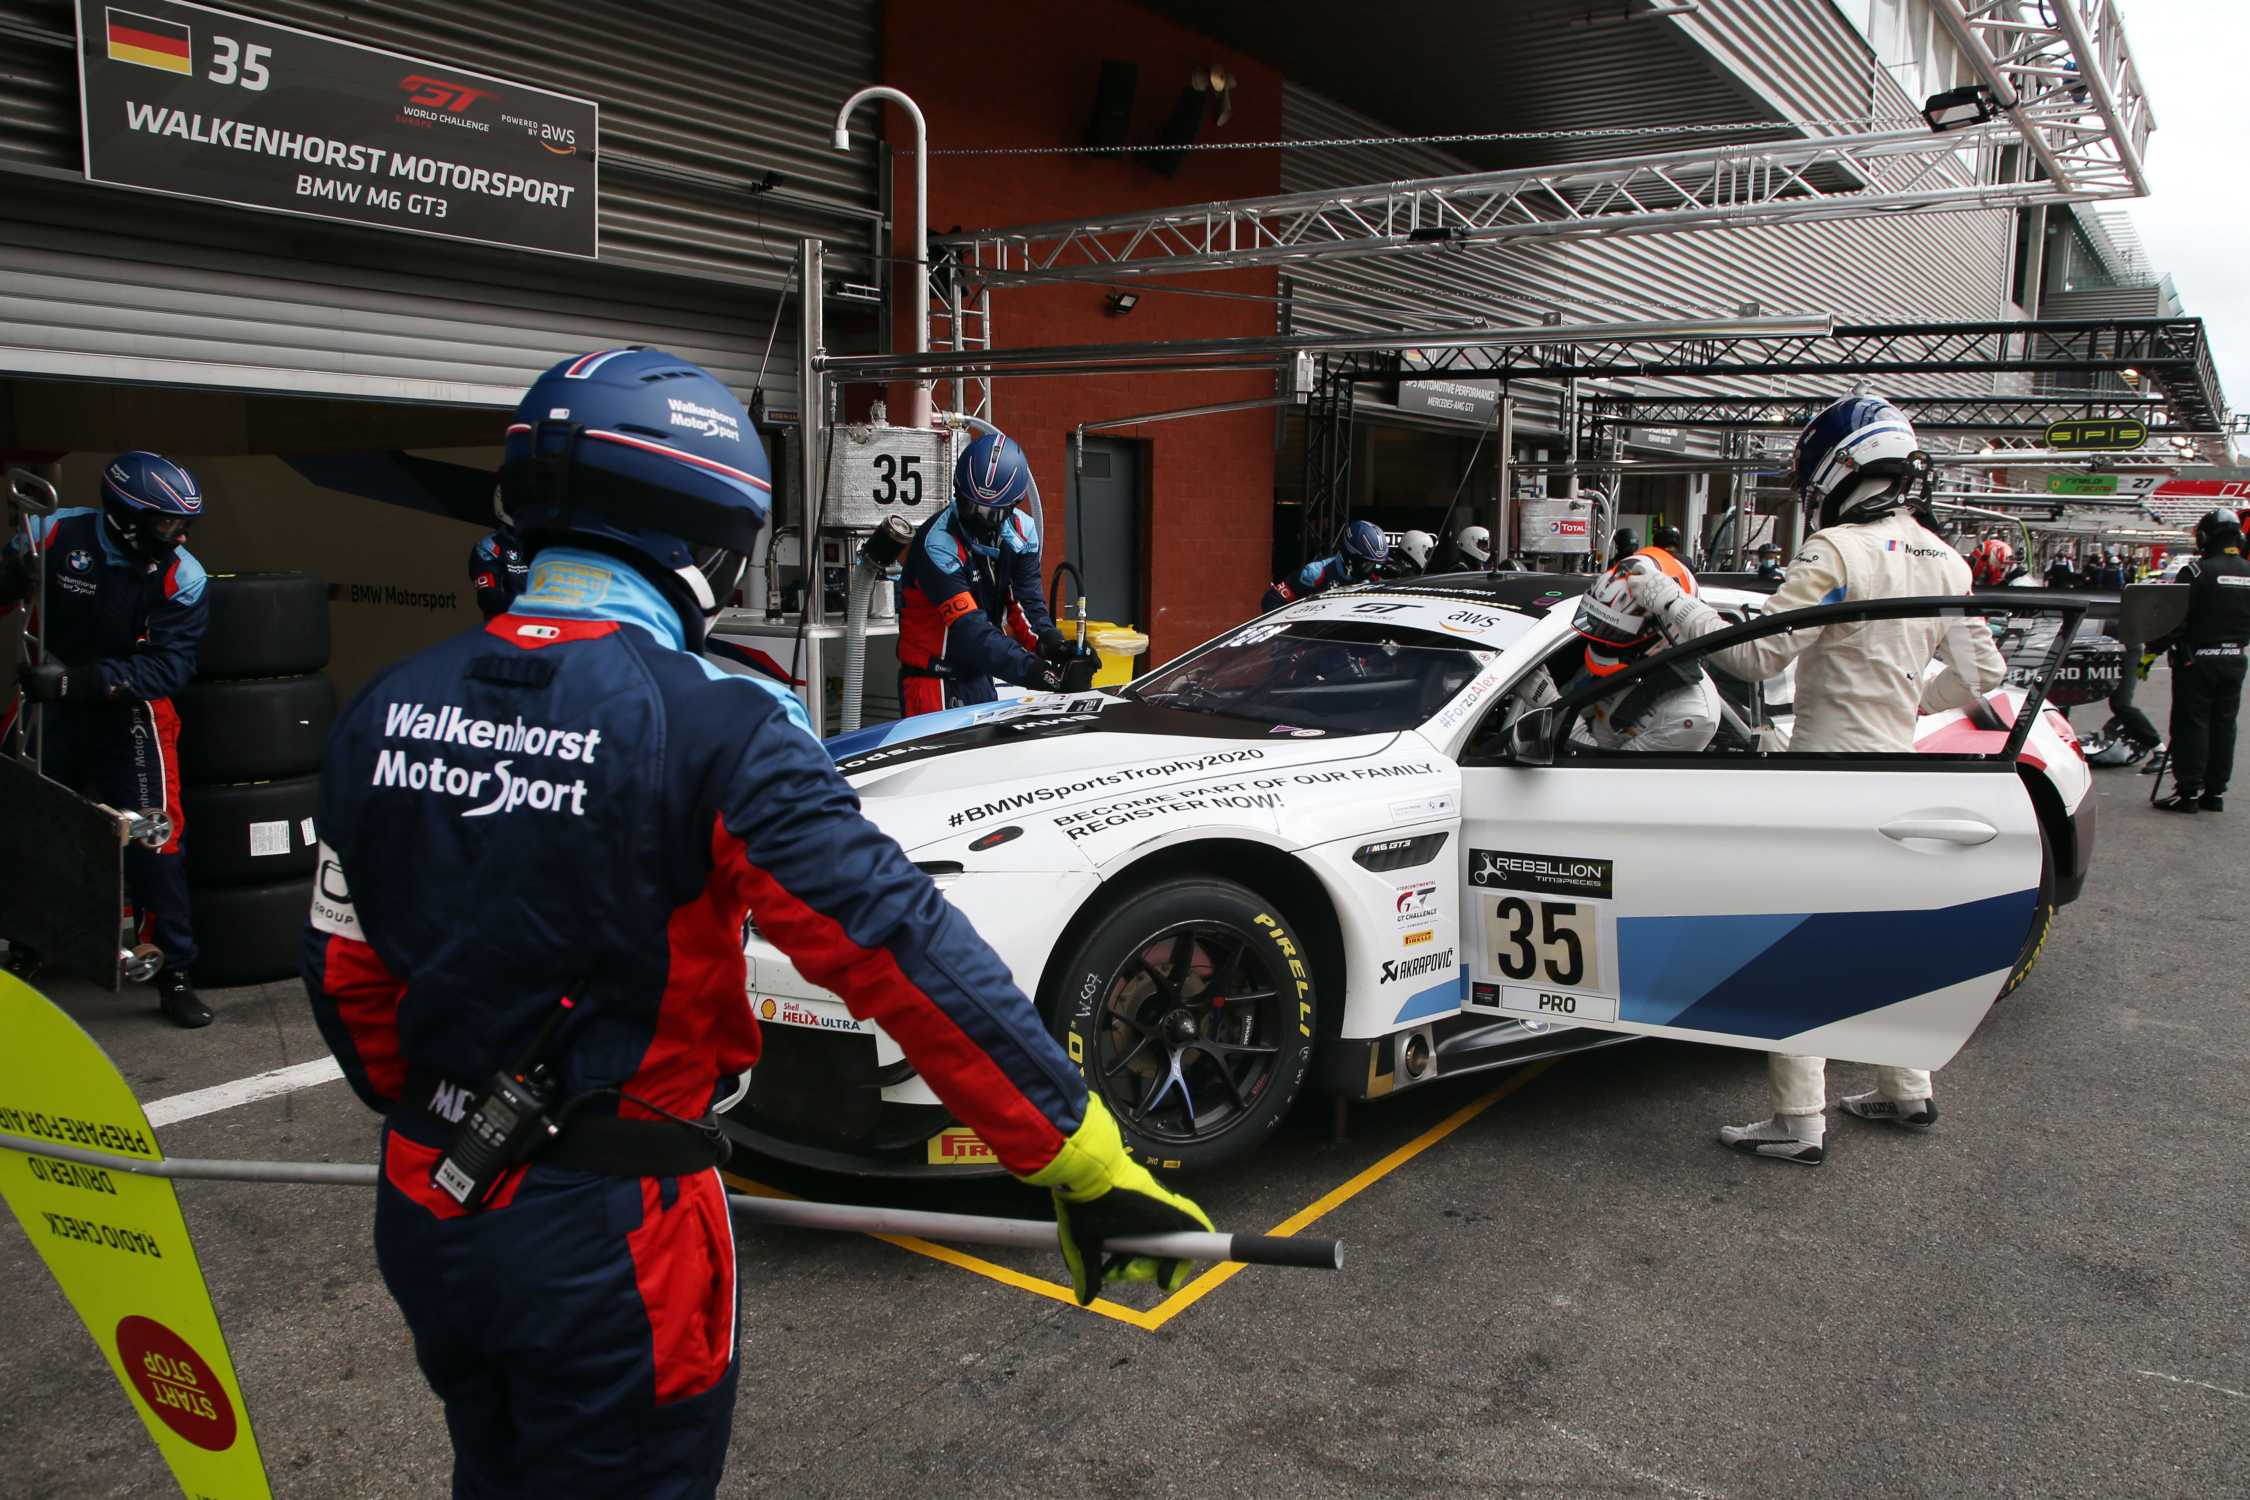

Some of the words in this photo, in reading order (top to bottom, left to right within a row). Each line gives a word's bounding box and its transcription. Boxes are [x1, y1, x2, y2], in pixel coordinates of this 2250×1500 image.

[207, 35, 273, 92] 35
[403, 105, 438, 121] WORLD
[439, 113, 490, 133] CHALLENGE
[501, 114, 539, 129] POWERED
[527, 127, 538, 137] BY
[541, 123, 576, 145] aws
[125, 100, 387, 175] WALKENHORST
[389, 152, 576, 209] MOTORSPORT
[296, 174, 362, 204] BMW
[366, 185, 402, 212] M6
[407, 193, 449, 219] GT3
[1418, 380, 1455, 394] AUTOMOTIVE
[1455, 385, 1495, 401] PERFORMANCE
[667, 398, 738, 429] Walkenhorst
[872, 453, 923, 506] 35
[2132, 478, 2154, 489] 27
[351, 584, 382, 605] BMW
[385, 586, 457, 612] Motorsport
[1447, 610, 1501, 628] aws
[1440, 672, 1499, 729] #ForzaAlex
[383, 702, 601, 764] Walkenhorst
[372, 750, 588, 817] MotorSport
[948, 748, 1265, 829] #BMWSportsTrophy2020
[1053, 794, 1178, 827] BECOME
[1179, 782, 1248, 799] PART
[1253, 777, 1289, 790] OF
[1293, 770, 1351, 785] OUR
[1351, 763, 1442, 780] FAMILY.
[1066, 799, 1209, 841] REGISTER
[1210, 792, 1286, 809] NOW!
[1389, 839, 1412, 850] GT3
[1496, 856, 1602, 879] REBELLION
[1535, 875, 1602, 887] TIMEPIECES
[315, 901, 355, 924] GROUP
[1405, 908, 1437, 921] CHALLENGE
[1496, 896, 1584, 987] 35
[1253, 912, 1313, 1038] PIRELLI
[784, 1002, 800, 1012] Shell
[1538, 993, 1577, 1014] PRO
[782, 1010, 821, 1026] HELIX
[821, 1016, 861, 1032] ULTRA
[22, 1110, 66, 1140] FOR
[59, 1116, 152, 1155] PREPARE
[941, 1134, 999, 1157] PIR
[28, 1156, 51, 1182] ID
[44, 1159, 118, 1195] DRIVER
[41, 1211, 102, 1245] CHECK
[101, 1224, 162, 1258] RADIO
[144, 1350, 197, 1385] STOP
[152, 1381, 218, 1421] START
